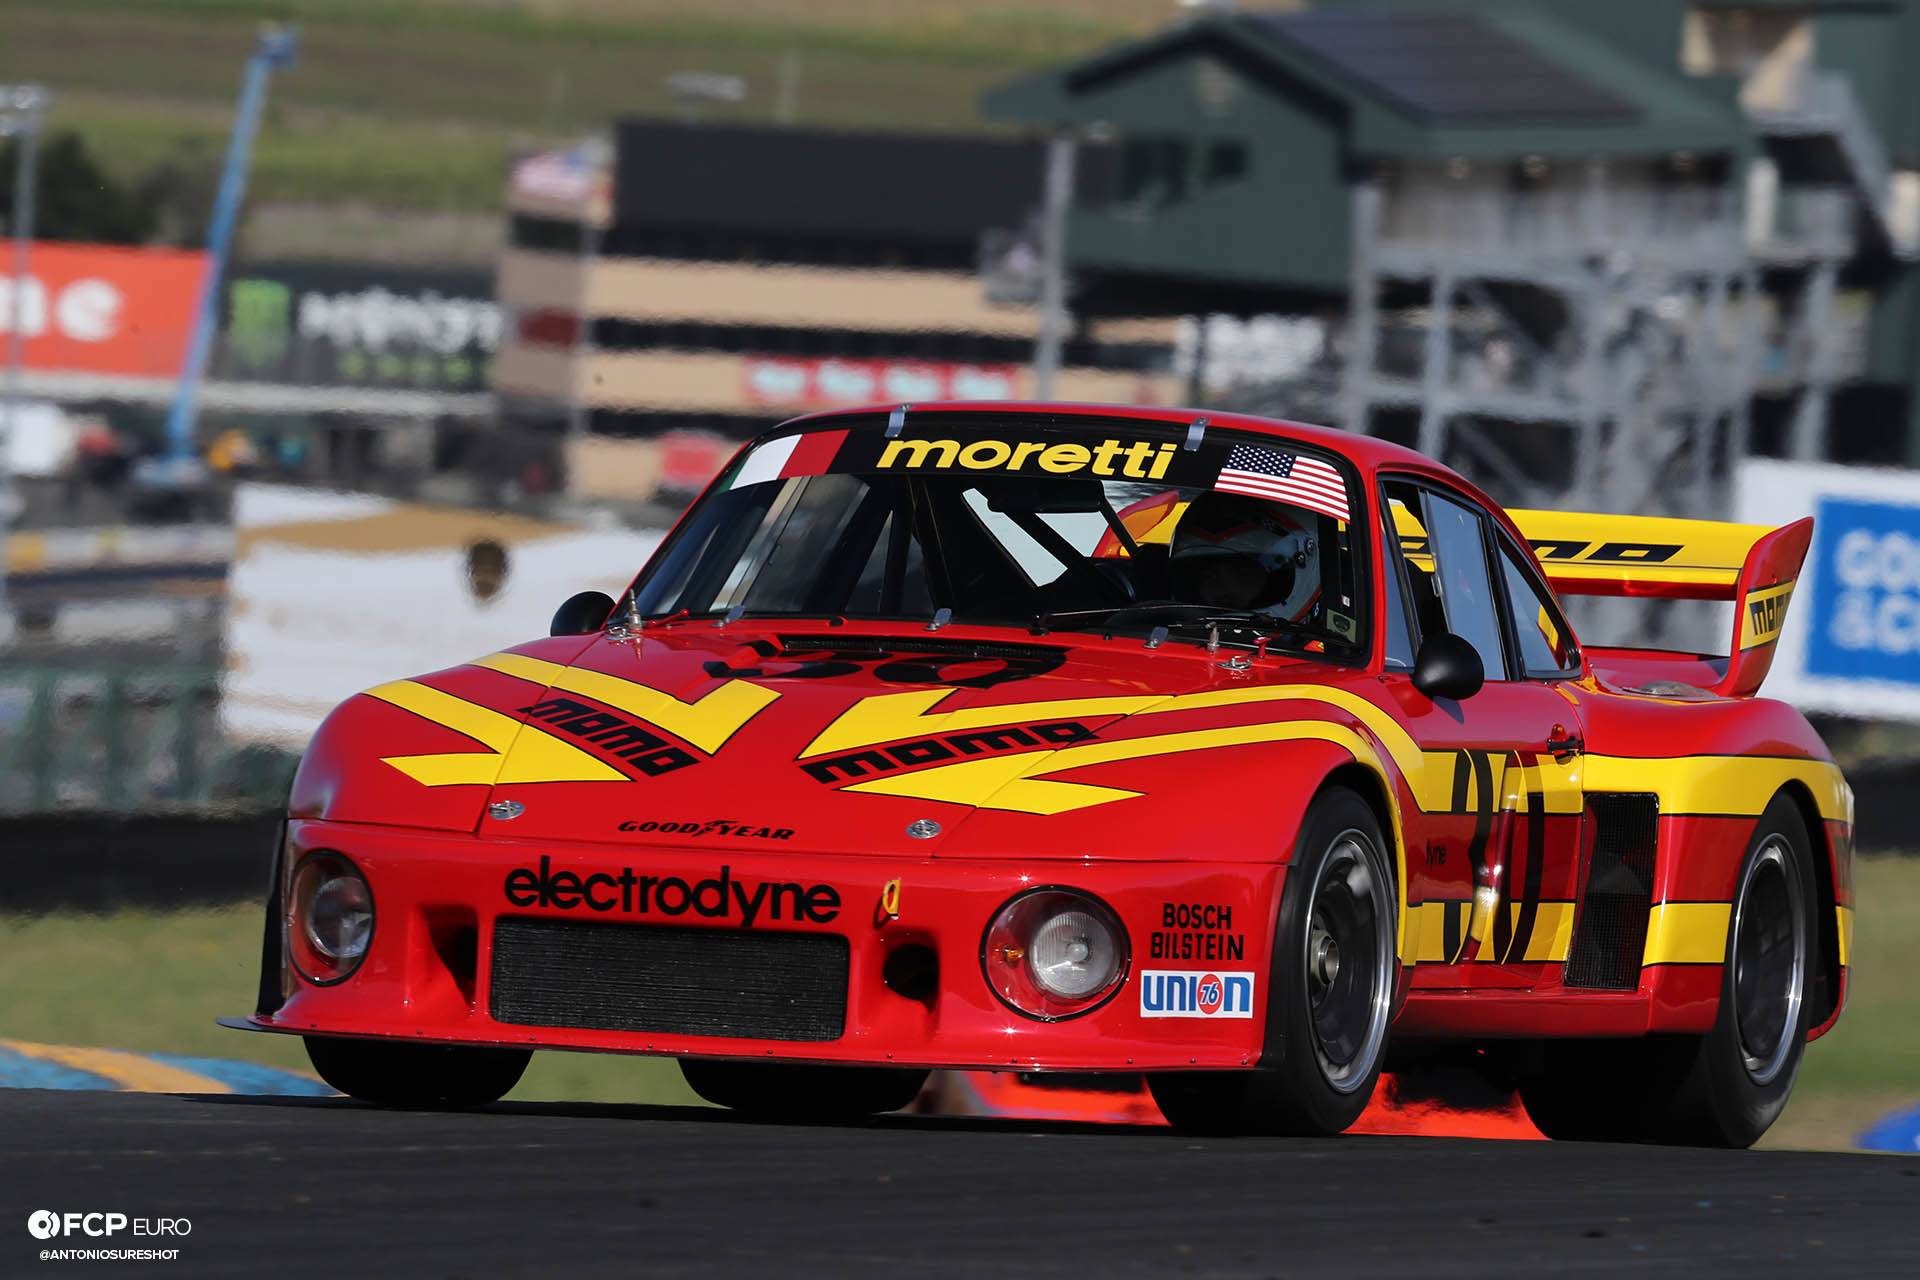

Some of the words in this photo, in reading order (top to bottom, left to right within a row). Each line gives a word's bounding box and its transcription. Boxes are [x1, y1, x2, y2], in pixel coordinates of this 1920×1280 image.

[876, 439, 1177, 479] moretti
[617, 820, 795, 840] GOODYEAR
[504, 855, 841, 927] electrodyne
[1163, 903, 1232, 930] BOSCH
[1150, 932, 1244, 960] BILSTEIN
